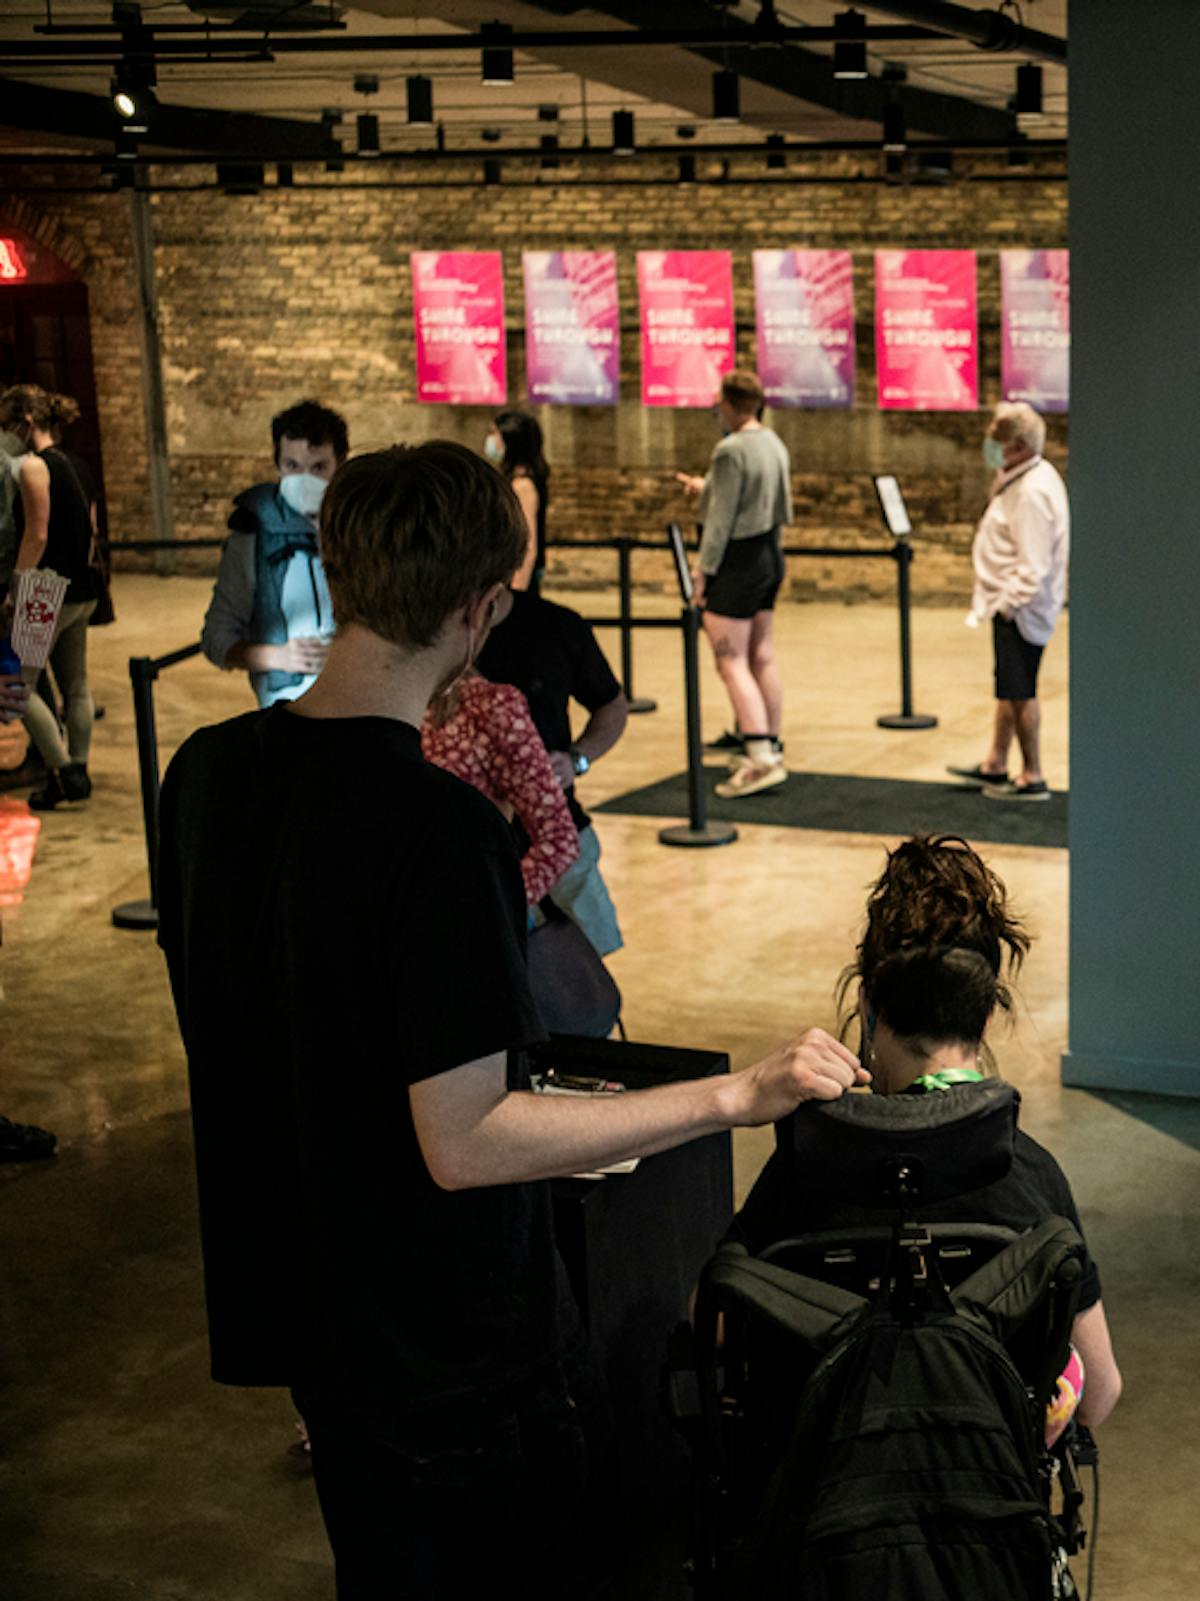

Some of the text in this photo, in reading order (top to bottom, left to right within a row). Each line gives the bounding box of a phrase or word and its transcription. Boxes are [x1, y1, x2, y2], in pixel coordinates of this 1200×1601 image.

[421, 326, 499, 344] THROUGH
[534, 327, 613, 345] THROUGH
[648, 327, 730, 345] THROUGH
[764, 328, 848, 346] THROUGH
[884, 329, 971, 347] THROUGH
